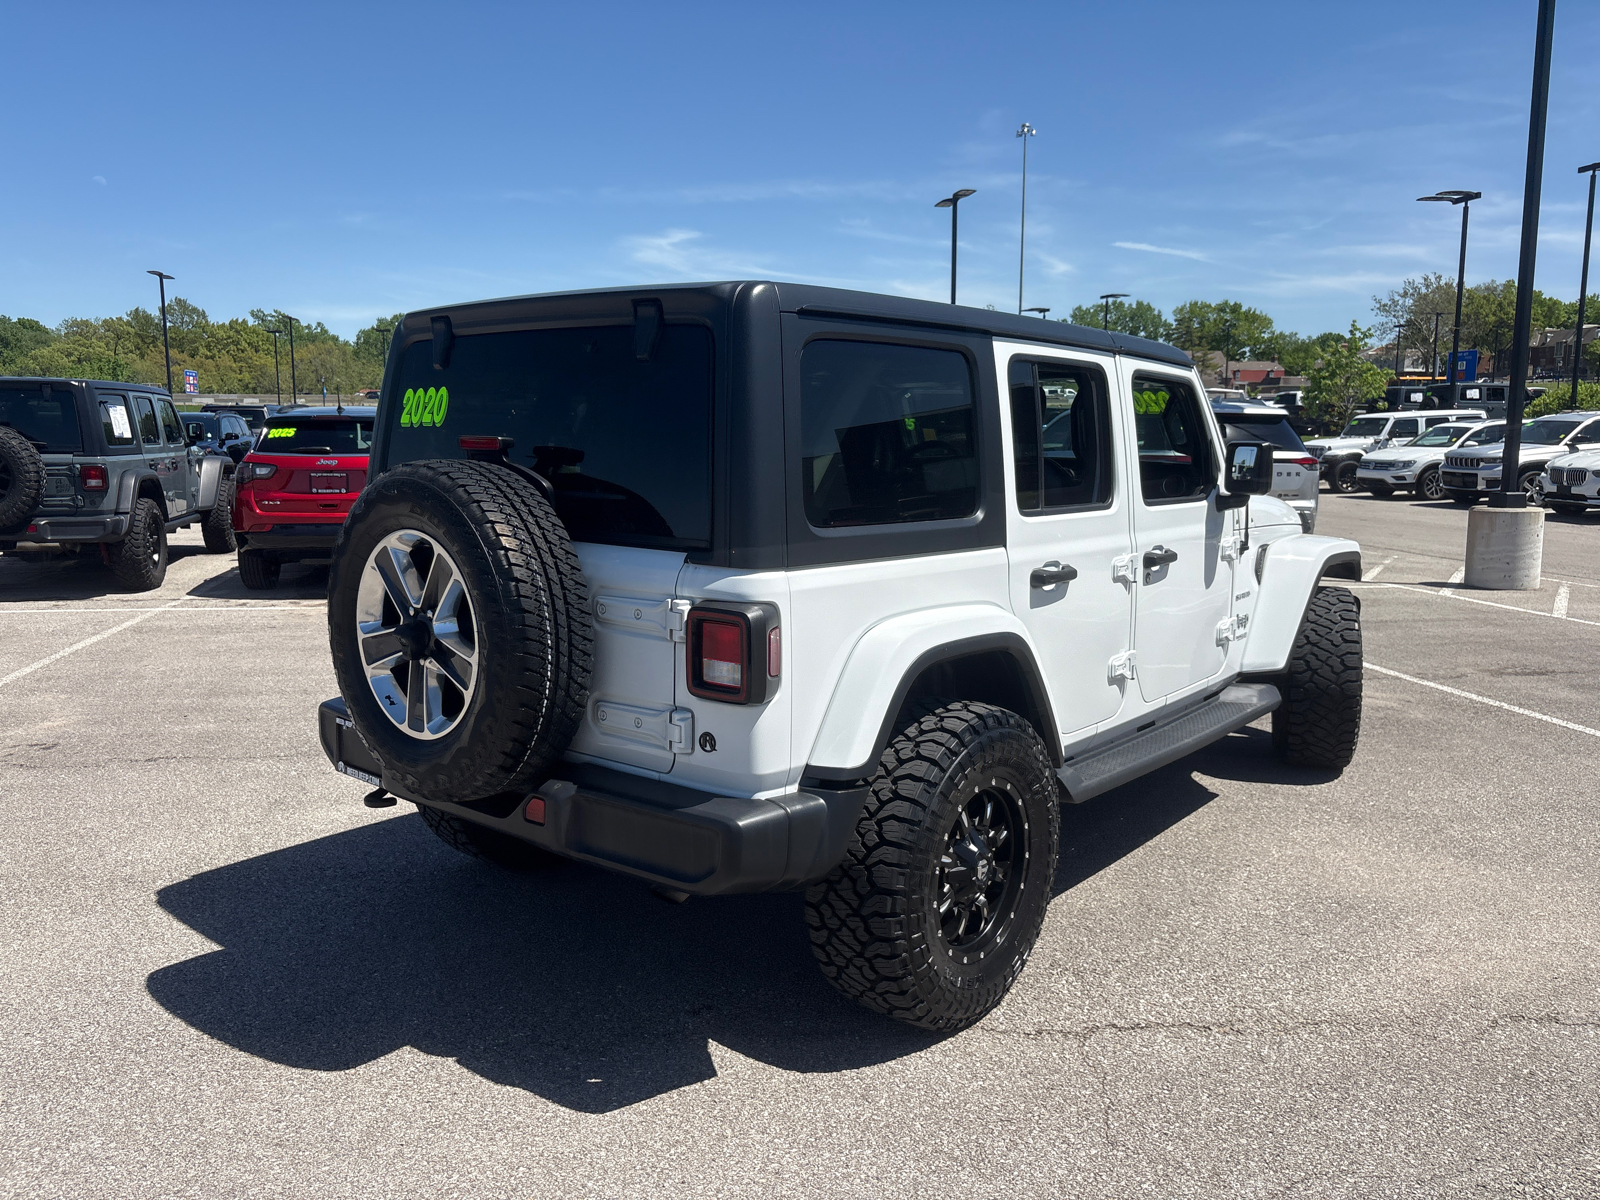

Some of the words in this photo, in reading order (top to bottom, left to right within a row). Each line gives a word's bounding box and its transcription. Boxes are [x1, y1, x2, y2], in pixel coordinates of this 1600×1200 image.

[401, 386, 449, 428] 2020
[267, 427, 297, 439] 2025
[316, 458, 338, 466] Jeep
